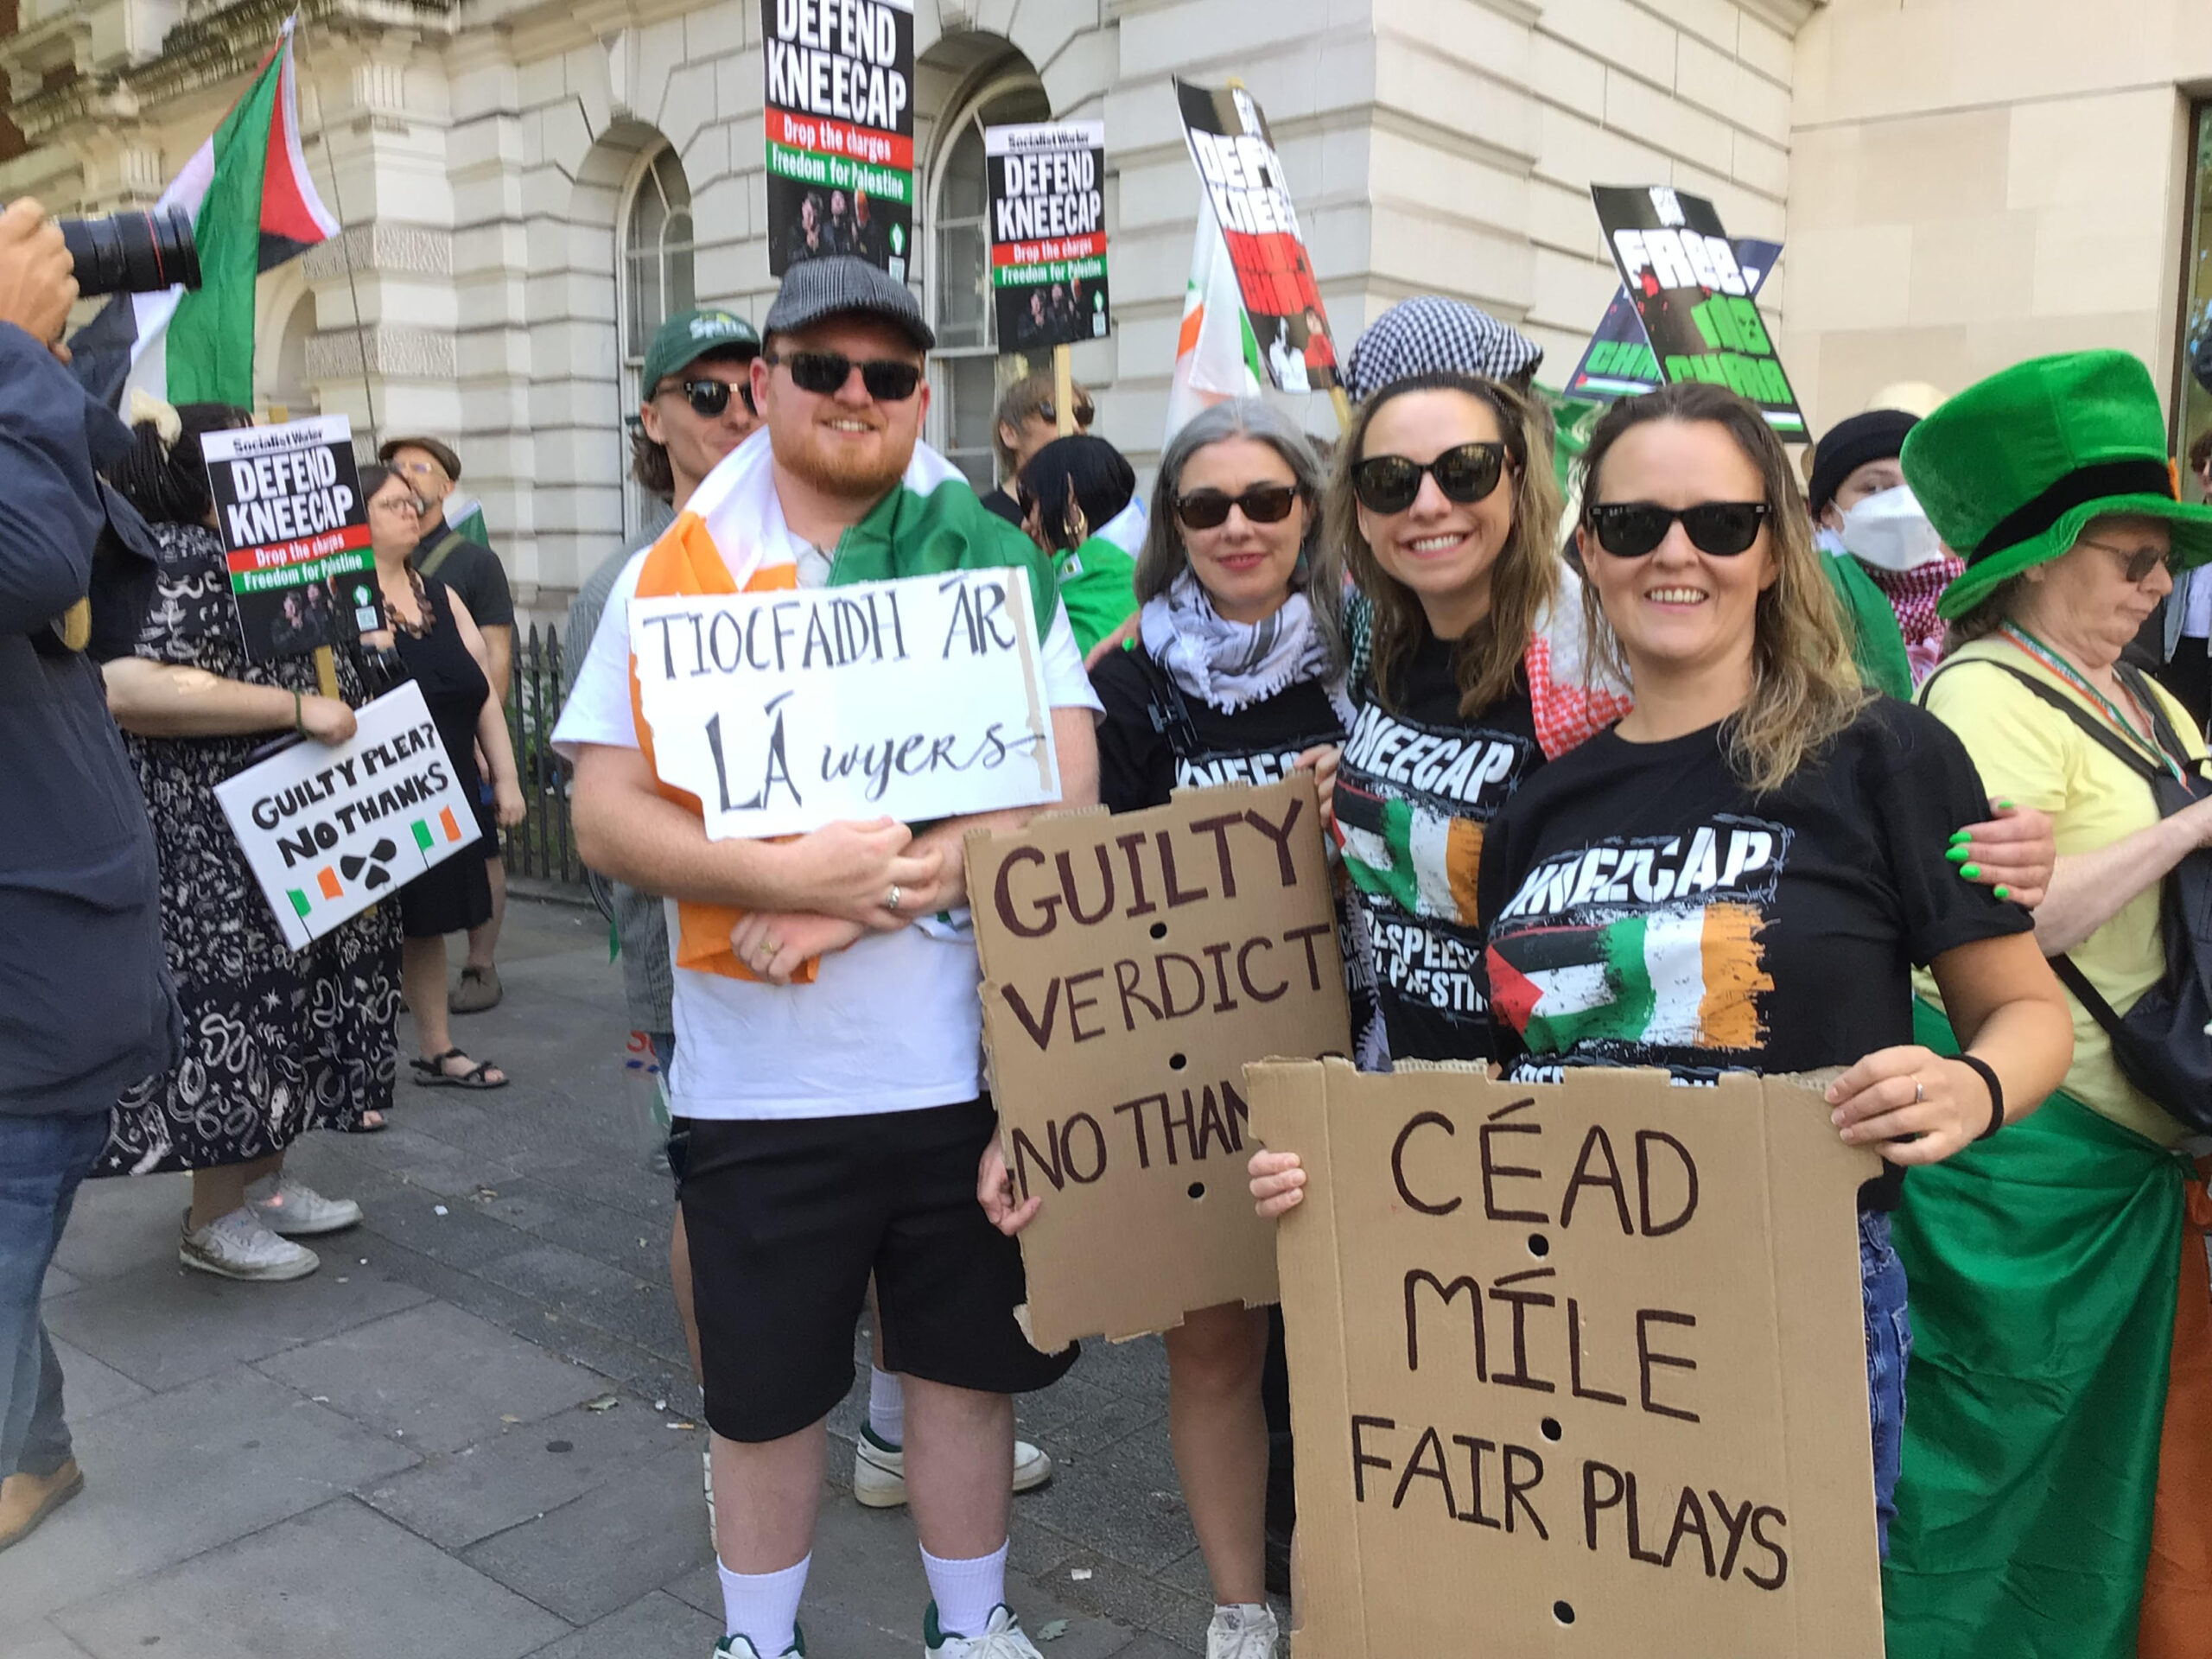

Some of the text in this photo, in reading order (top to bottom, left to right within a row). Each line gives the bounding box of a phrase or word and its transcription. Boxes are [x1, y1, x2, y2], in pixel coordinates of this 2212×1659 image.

[777, 0, 896, 67] DEFEND
[768, 37, 906, 130] KNEECAP
[784, 114, 891, 162] Drop the charges
[772, 143, 903, 200] Freedom for Palestine
[1004, 149, 1094, 198] DEFEND
[996, 190, 1101, 242] KNEECAP
[1002, 259, 1102, 285] Freedom for Palestine
[1014, 237, 1092, 264] Drop the charges
[231, 446, 337, 503] DEFEND
[233, 433, 291, 455] Socialist
[226, 485, 353, 548] KNEECAP
[243, 567, 299, 592] Freedom
[302, 563, 319, 582] for
[255, 547, 287, 567] Drop
[289, 543, 310, 560] the
[643, 588, 910, 680] TIOCFAIDH
[251, 722, 435, 830] GUILTY PLEA?
[276, 762, 448, 868] NO THANKS
[994, 798, 1303, 938] GUILTY
[1001, 923, 1331, 1051] VERDICT
[1013, 1081, 1249, 1199] NO THAN
[1391, 1097, 1699, 1237] CÉAD
[1404, 1267, 1700, 1424] MÍLE
[1352, 1414, 1789, 1591] FAIR PLAYS
